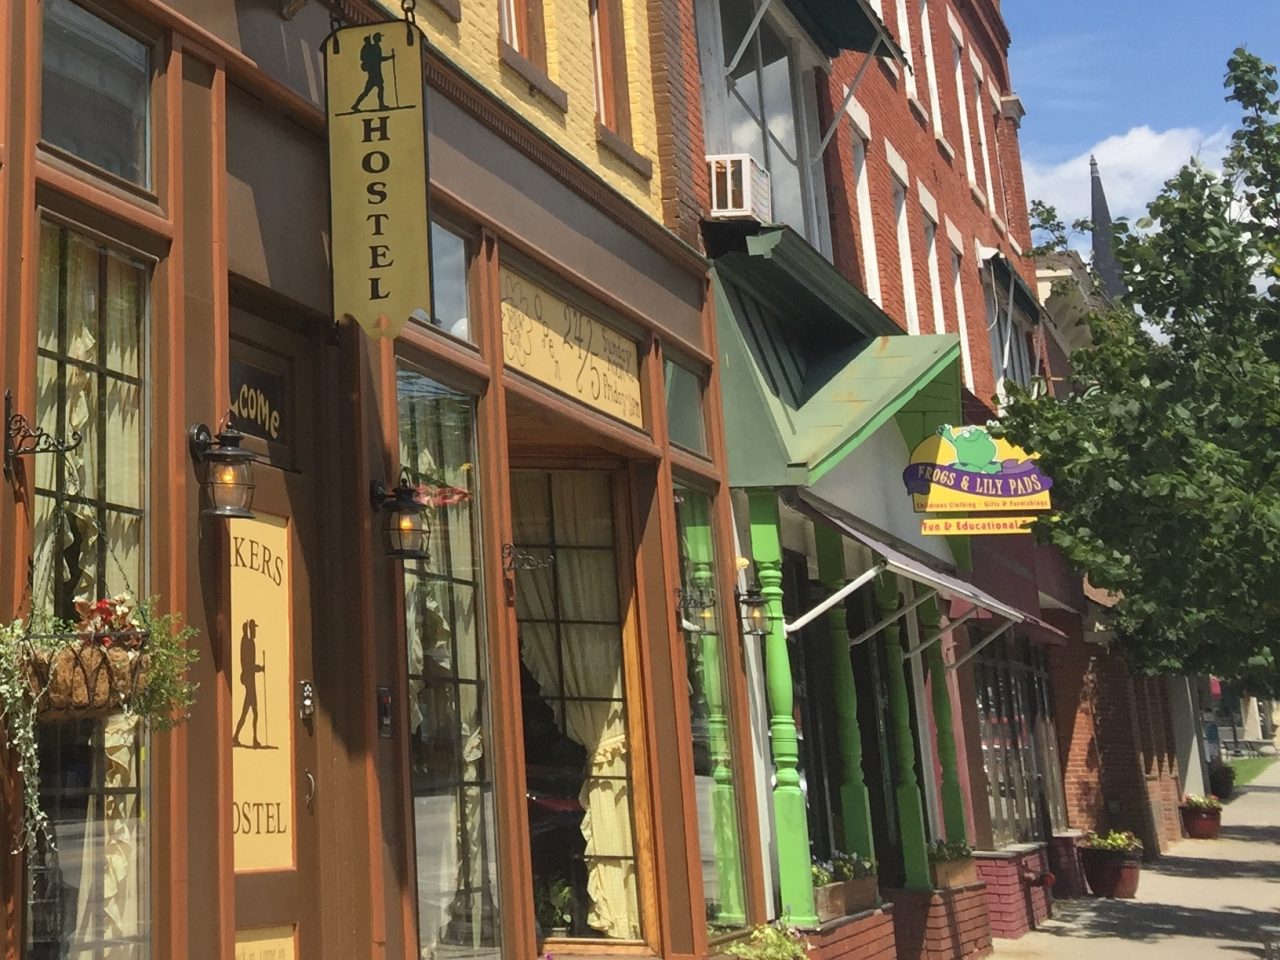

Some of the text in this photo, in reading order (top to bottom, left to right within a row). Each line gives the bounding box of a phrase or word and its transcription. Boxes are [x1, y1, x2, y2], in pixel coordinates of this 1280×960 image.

[361, 116, 394, 301] HOSTEL
[918, 465, 1042, 496] FROGS & LILY PADS
[923, 522, 940, 531] Fun
[944, 522, 952, 531] &
[956, 520, 1019, 530] Educational
[230, 536, 283, 587] KERS
